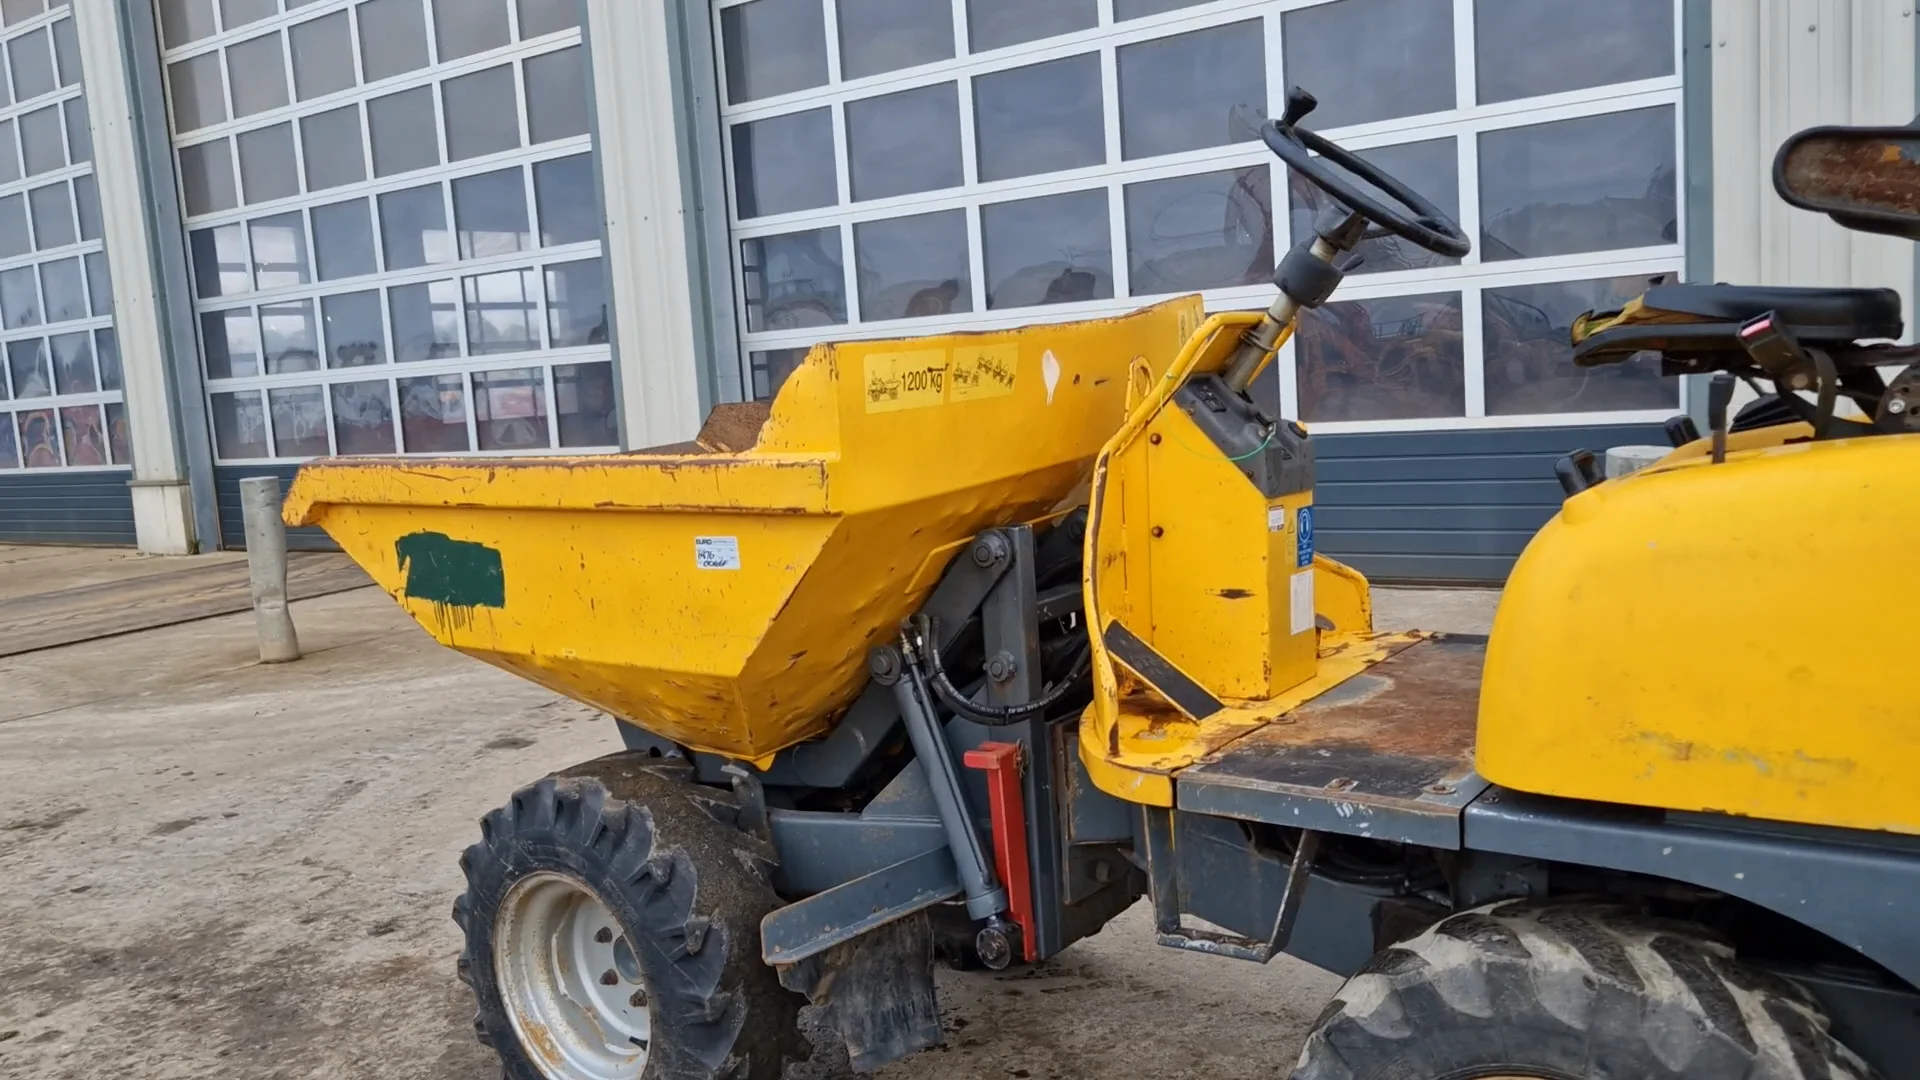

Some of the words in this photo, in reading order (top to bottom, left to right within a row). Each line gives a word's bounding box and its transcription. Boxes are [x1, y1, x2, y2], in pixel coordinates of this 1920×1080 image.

[901, 370, 928, 392] 1200
[929, 370, 943, 393] kg
[695, 538, 713, 546] EURO
